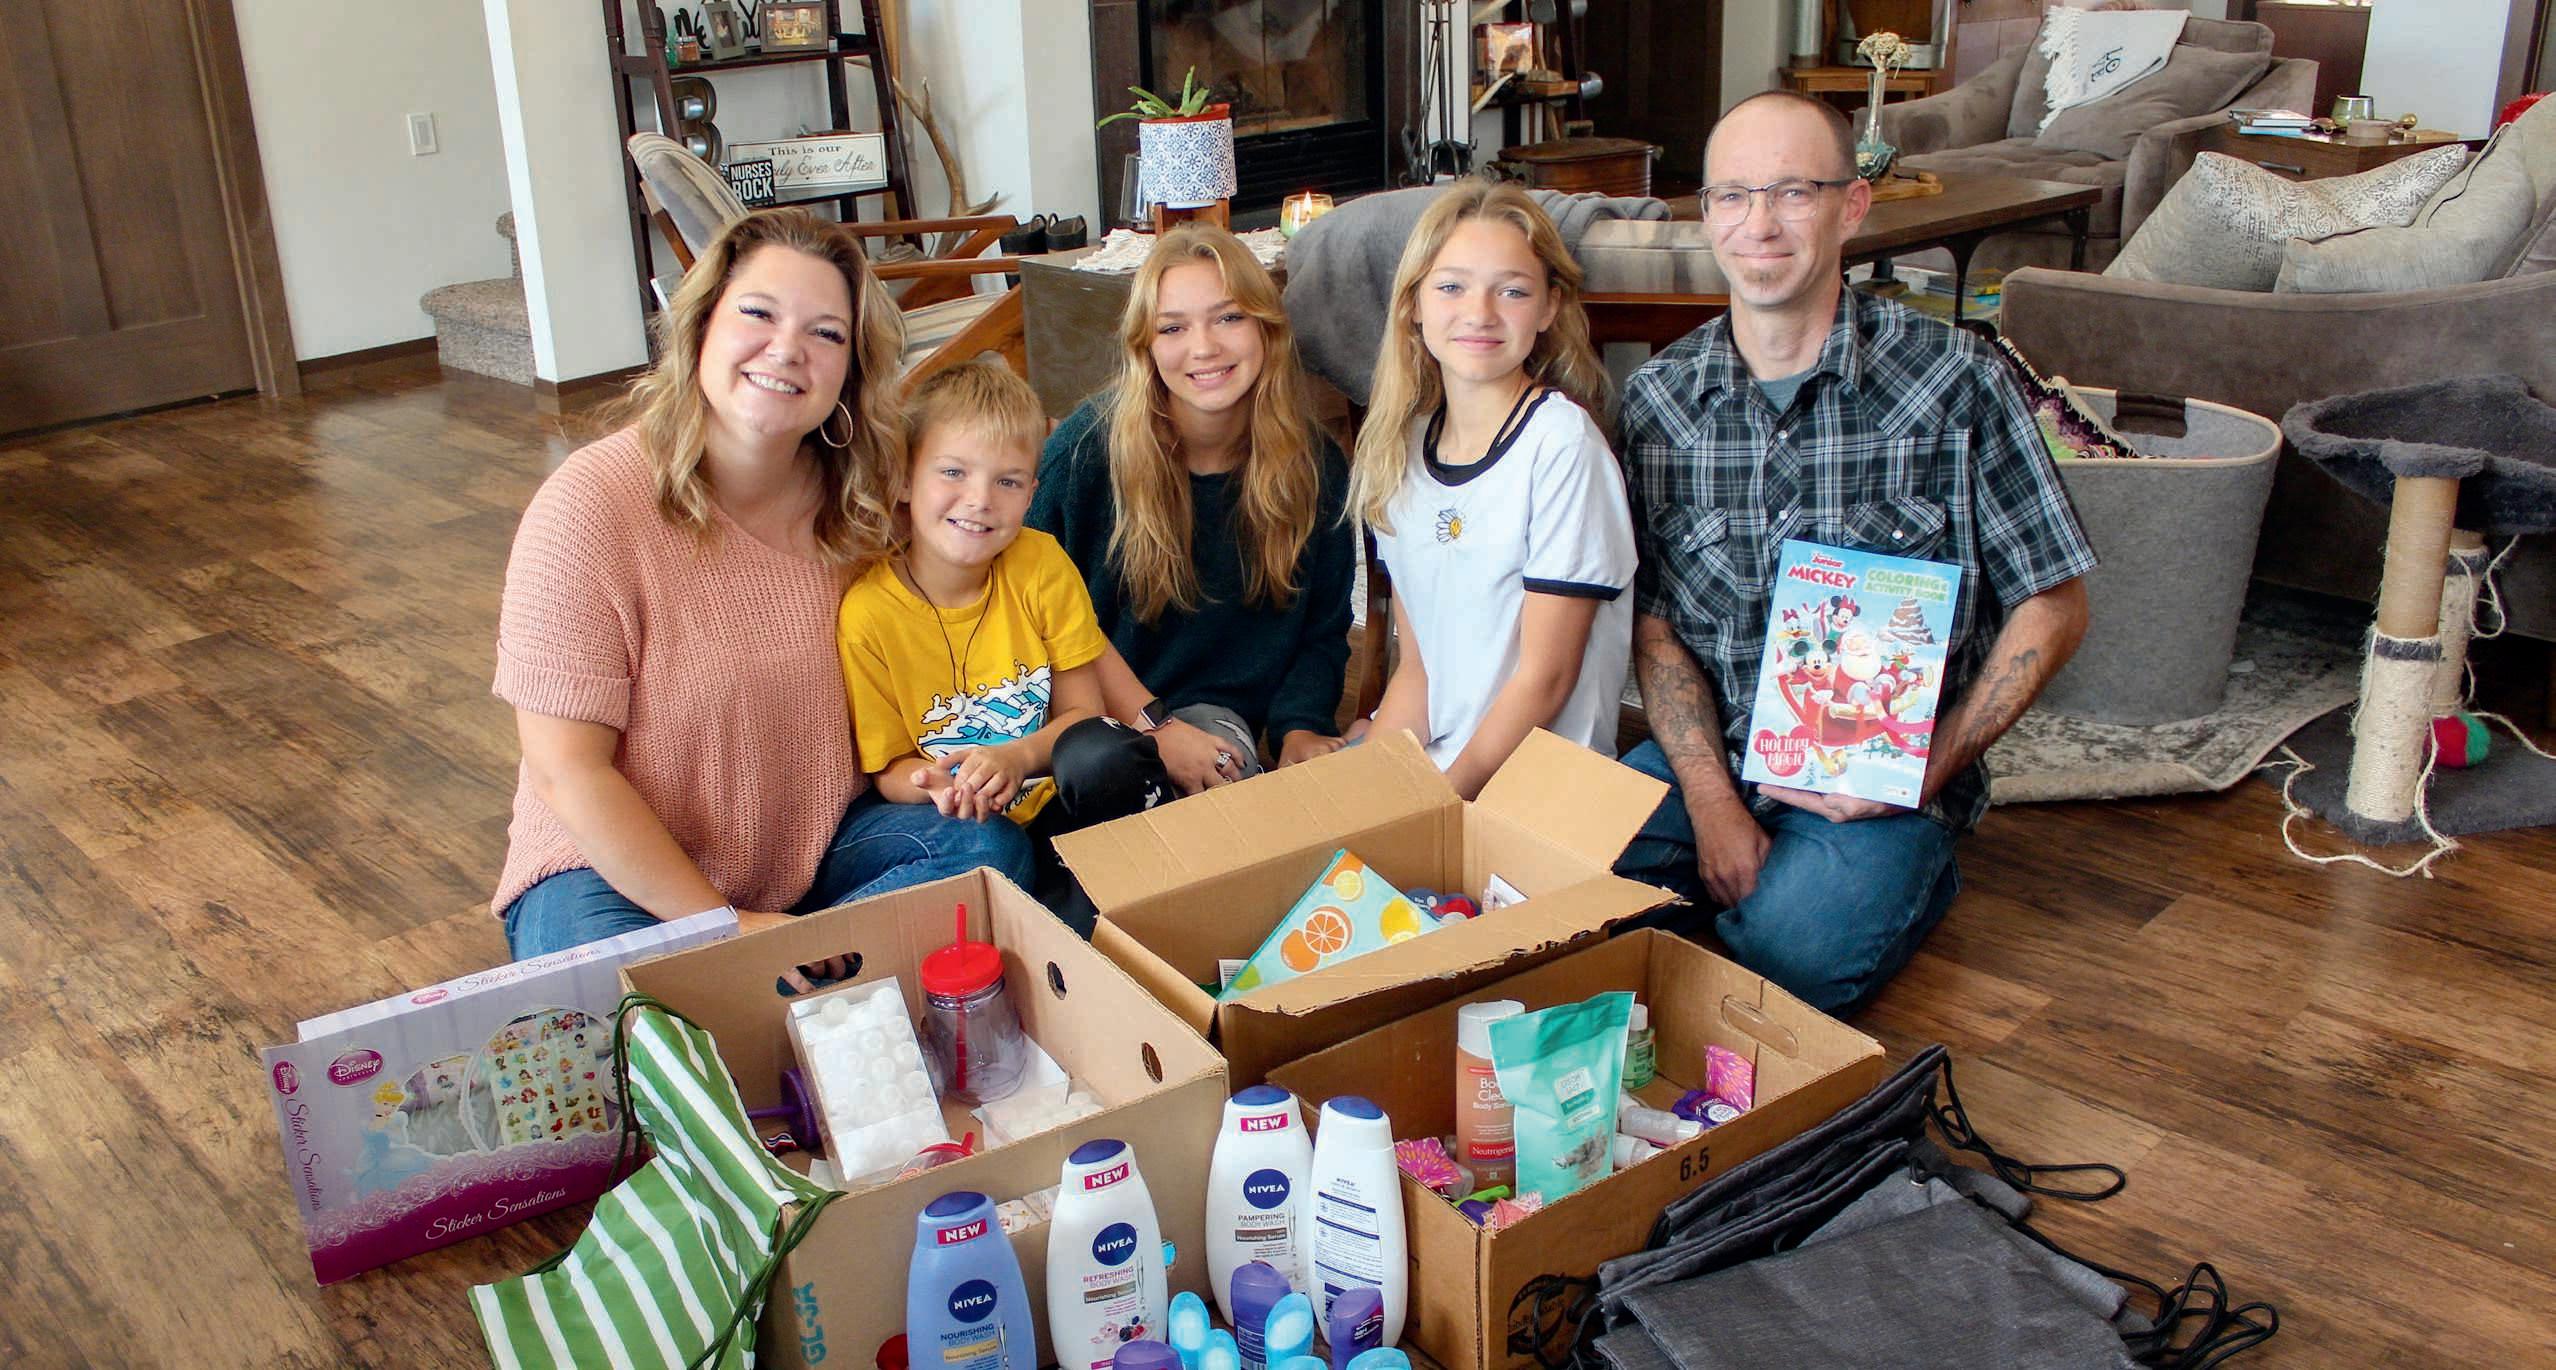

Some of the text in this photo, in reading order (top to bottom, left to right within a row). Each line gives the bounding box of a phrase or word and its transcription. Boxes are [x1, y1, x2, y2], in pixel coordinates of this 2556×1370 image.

[768, 145, 842, 156] This is our
[730, 161, 773, 181] NURSES
[797, 154, 829, 177] Ever
[834, 150, 877, 176] After
[732, 177, 775, 201] ROCK
[1787, 565, 1857, 589] MICKEY
[1867, 569, 1940, 590] COLORING
[1865, 581, 1912, 597] ACTIVITY
[1760, 738, 1809, 752] HOLIDAY
[1767, 751, 1803, 767] MAGIC
[457, 947, 601, 993] Sticker Sensations
[1247, 1116, 1283, 1131] NEW
[284, 1098, 323, 1212] Sticker Sensations
[1471, 1145, 1515, 1156] Neutrogena
[1679, 1147, 1710, 1182] 6.5
[1090, 1165, 1126, 1188] NEW
[1248, 1183, 1286, 1195] NIVEA
[425, 1186, 566, 1240] Sticker Sensations
[1237, 1212, 1285, 1222] PAMPERING
[945, 1222, 982, 1242] NEW
[1097, 1236, 1134, 1253] NIVEA
[1083, 1264, 1134, 1283] REFRESHING
[953, 1293, 993, 1311] NIVEA
[940, 1323, 994, 1341] NOURISHING
